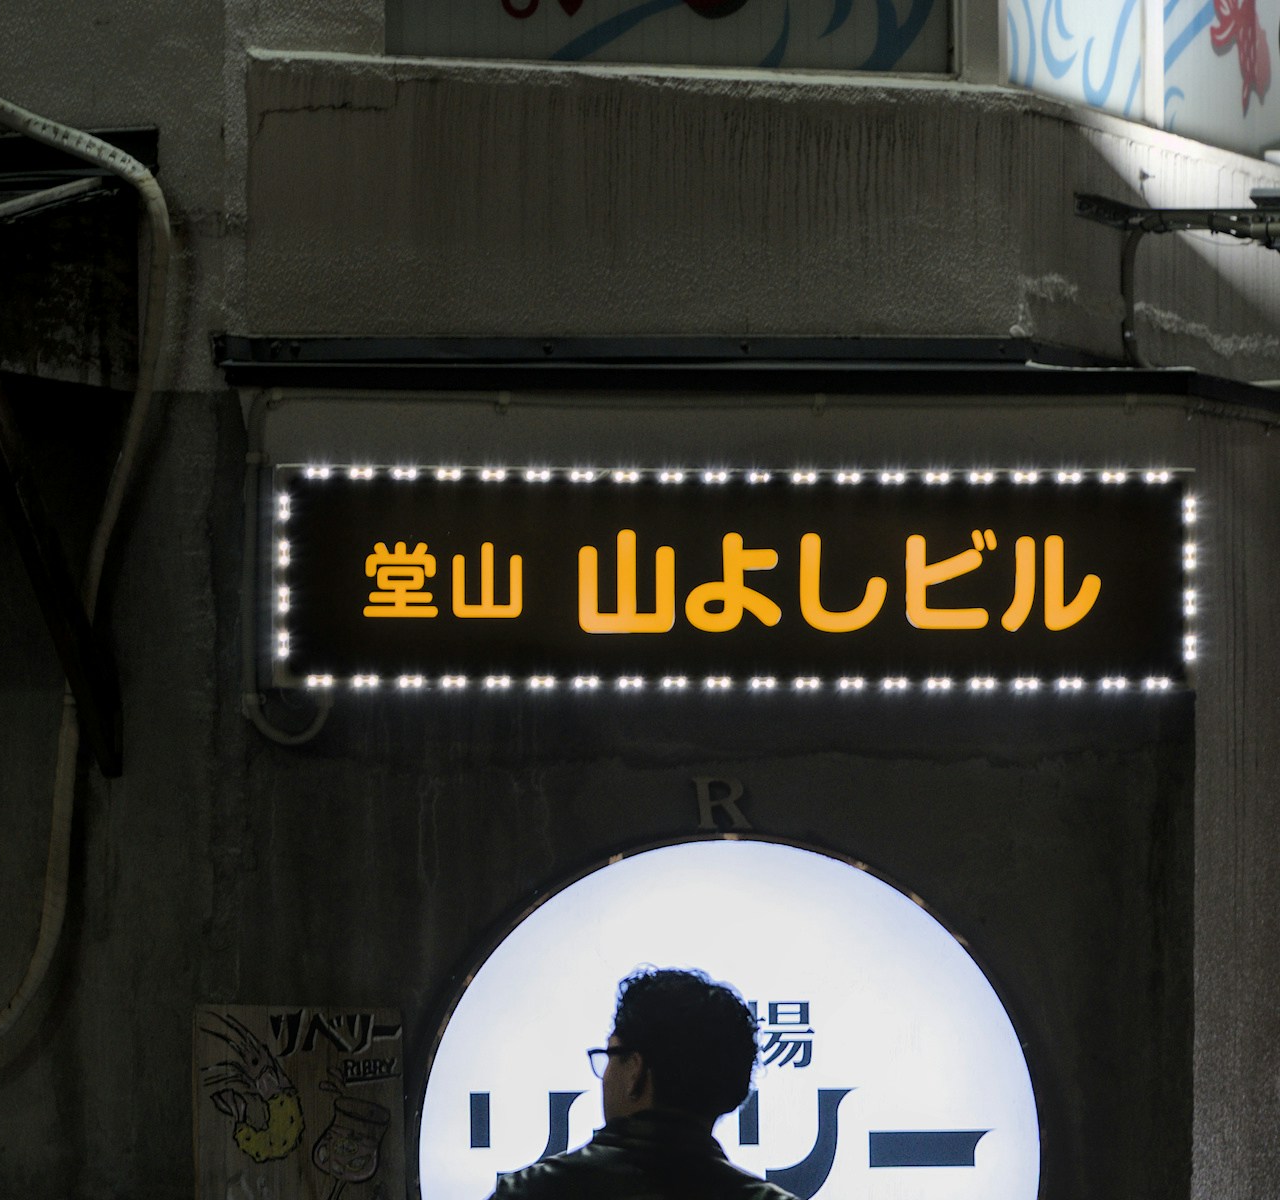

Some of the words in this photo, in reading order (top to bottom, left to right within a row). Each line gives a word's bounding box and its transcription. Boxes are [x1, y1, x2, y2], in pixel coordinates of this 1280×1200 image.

[363, 541, 523, 619] 堂山
[578, 528, 1101, 634] 山よしビル
[690, 776, 753, 830] R
[270, 1008, 403, 1057] リベリー
